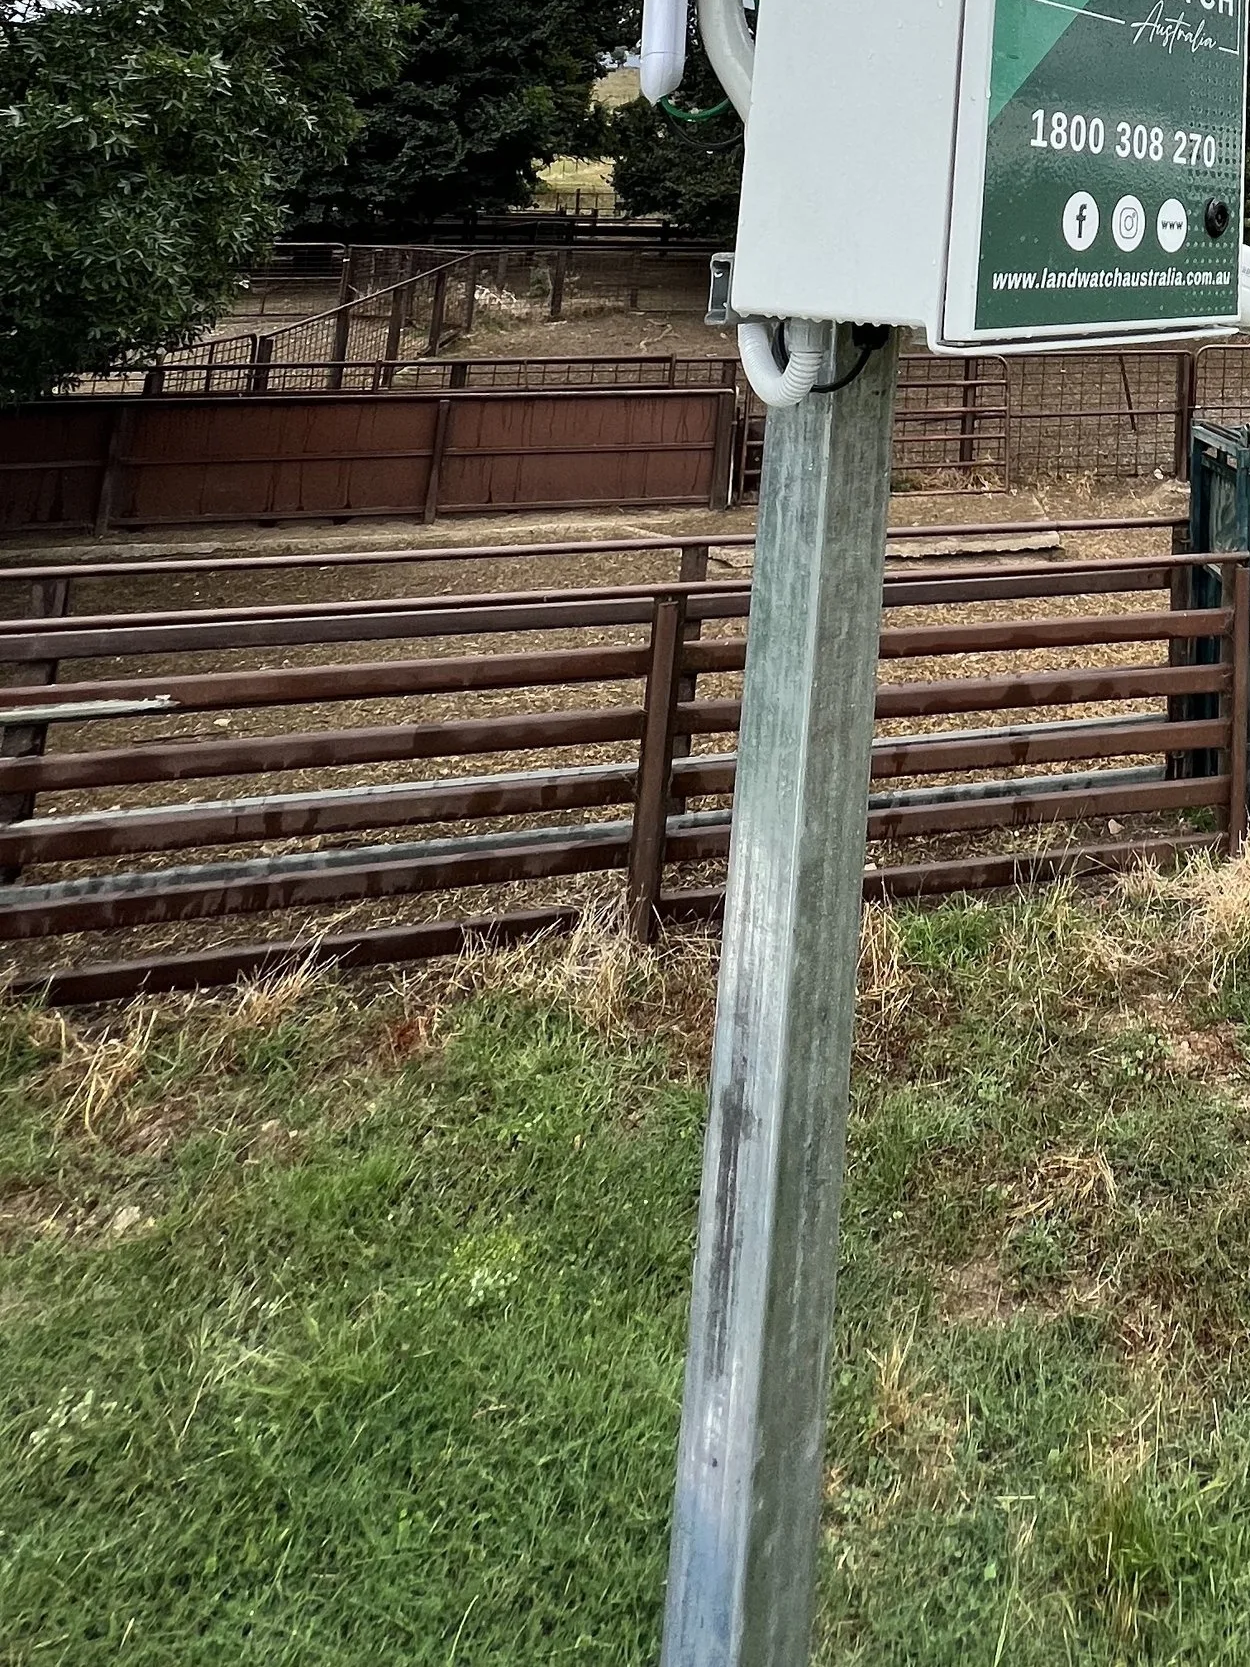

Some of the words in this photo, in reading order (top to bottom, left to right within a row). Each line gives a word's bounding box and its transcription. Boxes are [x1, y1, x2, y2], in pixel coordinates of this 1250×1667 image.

[1130, 0, 1217, 54] Australia
[1030, 109, 1105, 154] 1800
[1115, 122, 1164, 161] 308
[1172, 131, 1216, 168] 270
[992, 268, 1231, 290] www.landwatchaustralia.com.au
